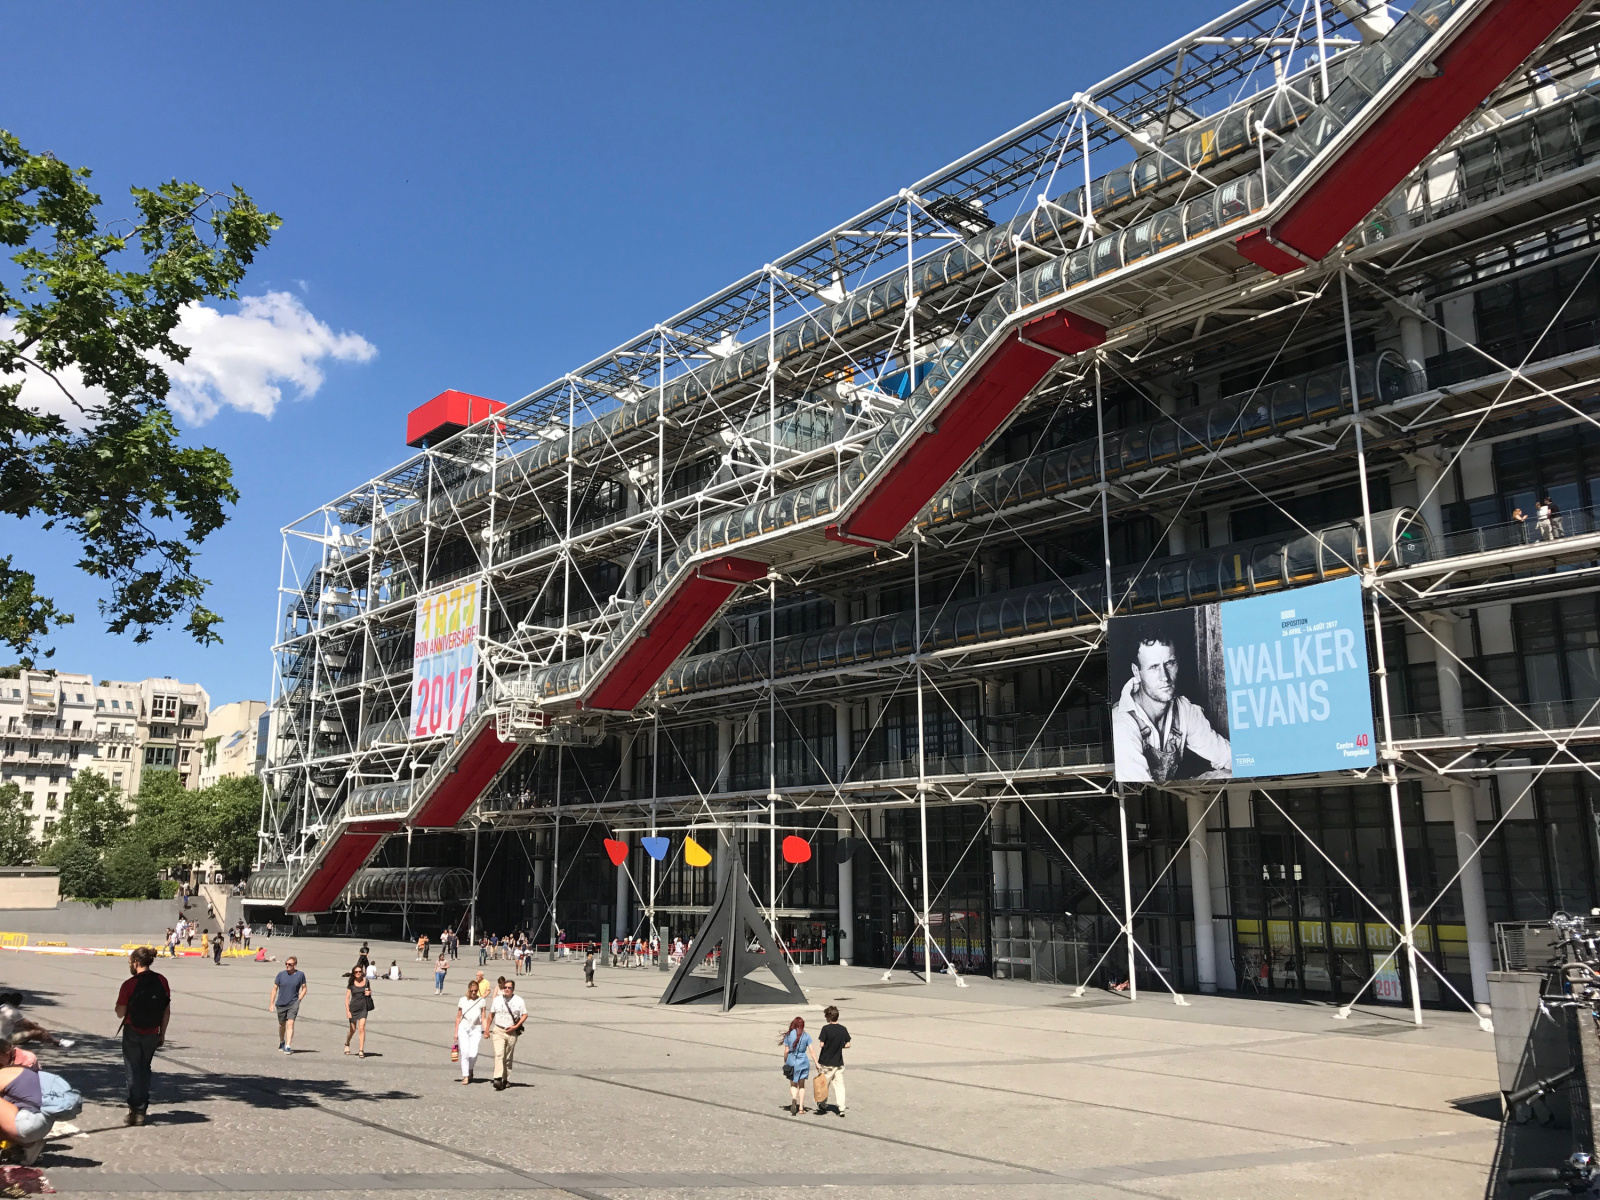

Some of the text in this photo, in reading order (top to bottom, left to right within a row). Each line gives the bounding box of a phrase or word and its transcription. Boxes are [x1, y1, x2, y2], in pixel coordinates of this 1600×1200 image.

[422, 583, 477, 639] 1977
[1281, 618, 1308, 628] EXPOSITION
[1289, 628, 1302, 636] AVRIL
[1326, 620, 1338, 629] 2017
[415, 639, 429, 658] BON
[1227, 628, 1358, 686] WALKER
[415, 667, 472, 736] 2017
[1231, 679, 1331, 730] EVANS
[1336, 733, 1368, 750] Centre 40
[1235, 757, 1255, 765] TERRA
[1343, 748, 1369, 757] Pompidou
[1376, 980, 1401, 997] 201
